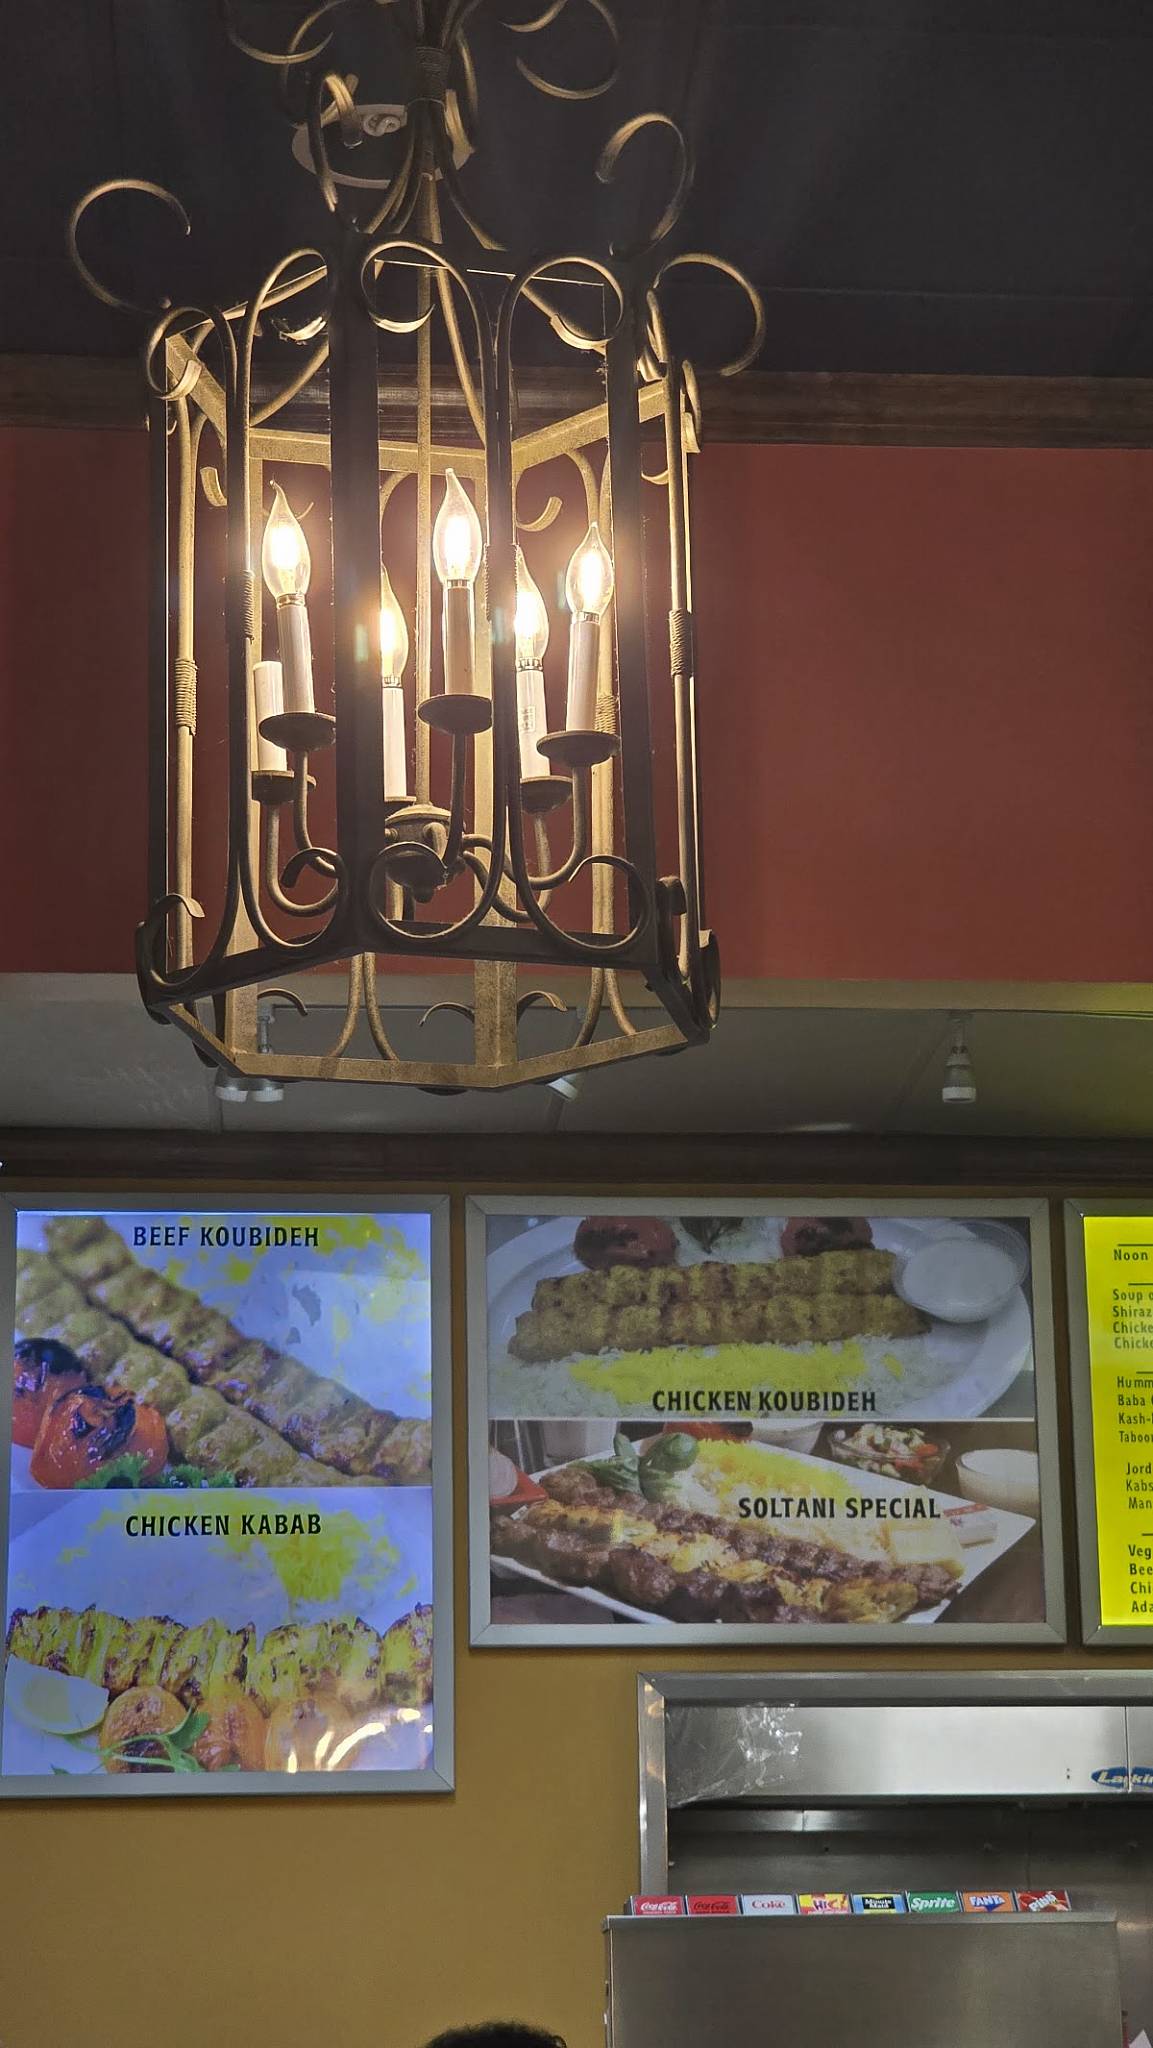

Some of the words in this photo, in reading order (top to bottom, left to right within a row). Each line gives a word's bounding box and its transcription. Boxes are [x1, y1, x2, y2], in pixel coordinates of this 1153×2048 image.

[133, 1226, 190, 1246] BEEF
[200, 1226, 319, 1247] KOUBIDEH
[1113, 1248, 1149, 1261] Noon
[1113, 1288, 1143, 1304] Soup
[1112, 1305, 1153, 1318] Shiraz
[652, 1391, 751, 1412] CHICKEN
[758, 1391, 876, 1412] KOUBIDEH
[1118, 1394, 1146, 1407] Baba
[1118, 1412, 1153, 1425] Kash-
[1126, 1462, 1152, 1475] Jord
[738, 1497, 835, 1519] SOLTANI
[845, 1497, 941, 1519] SPECIAL
[1128, 1497, 1152, 1510] Man
[126, 1515, 230, 1537] CHICKEN
[241, 1513, 322, 1535] KABAB
[1128, 1544, 1152, 1560] Veg
[1129, 1562, 1153, 1576] Bee
[1130, 1581, 1152, 1595] Chi
[911, 1897, 956, 1911] Sprite
